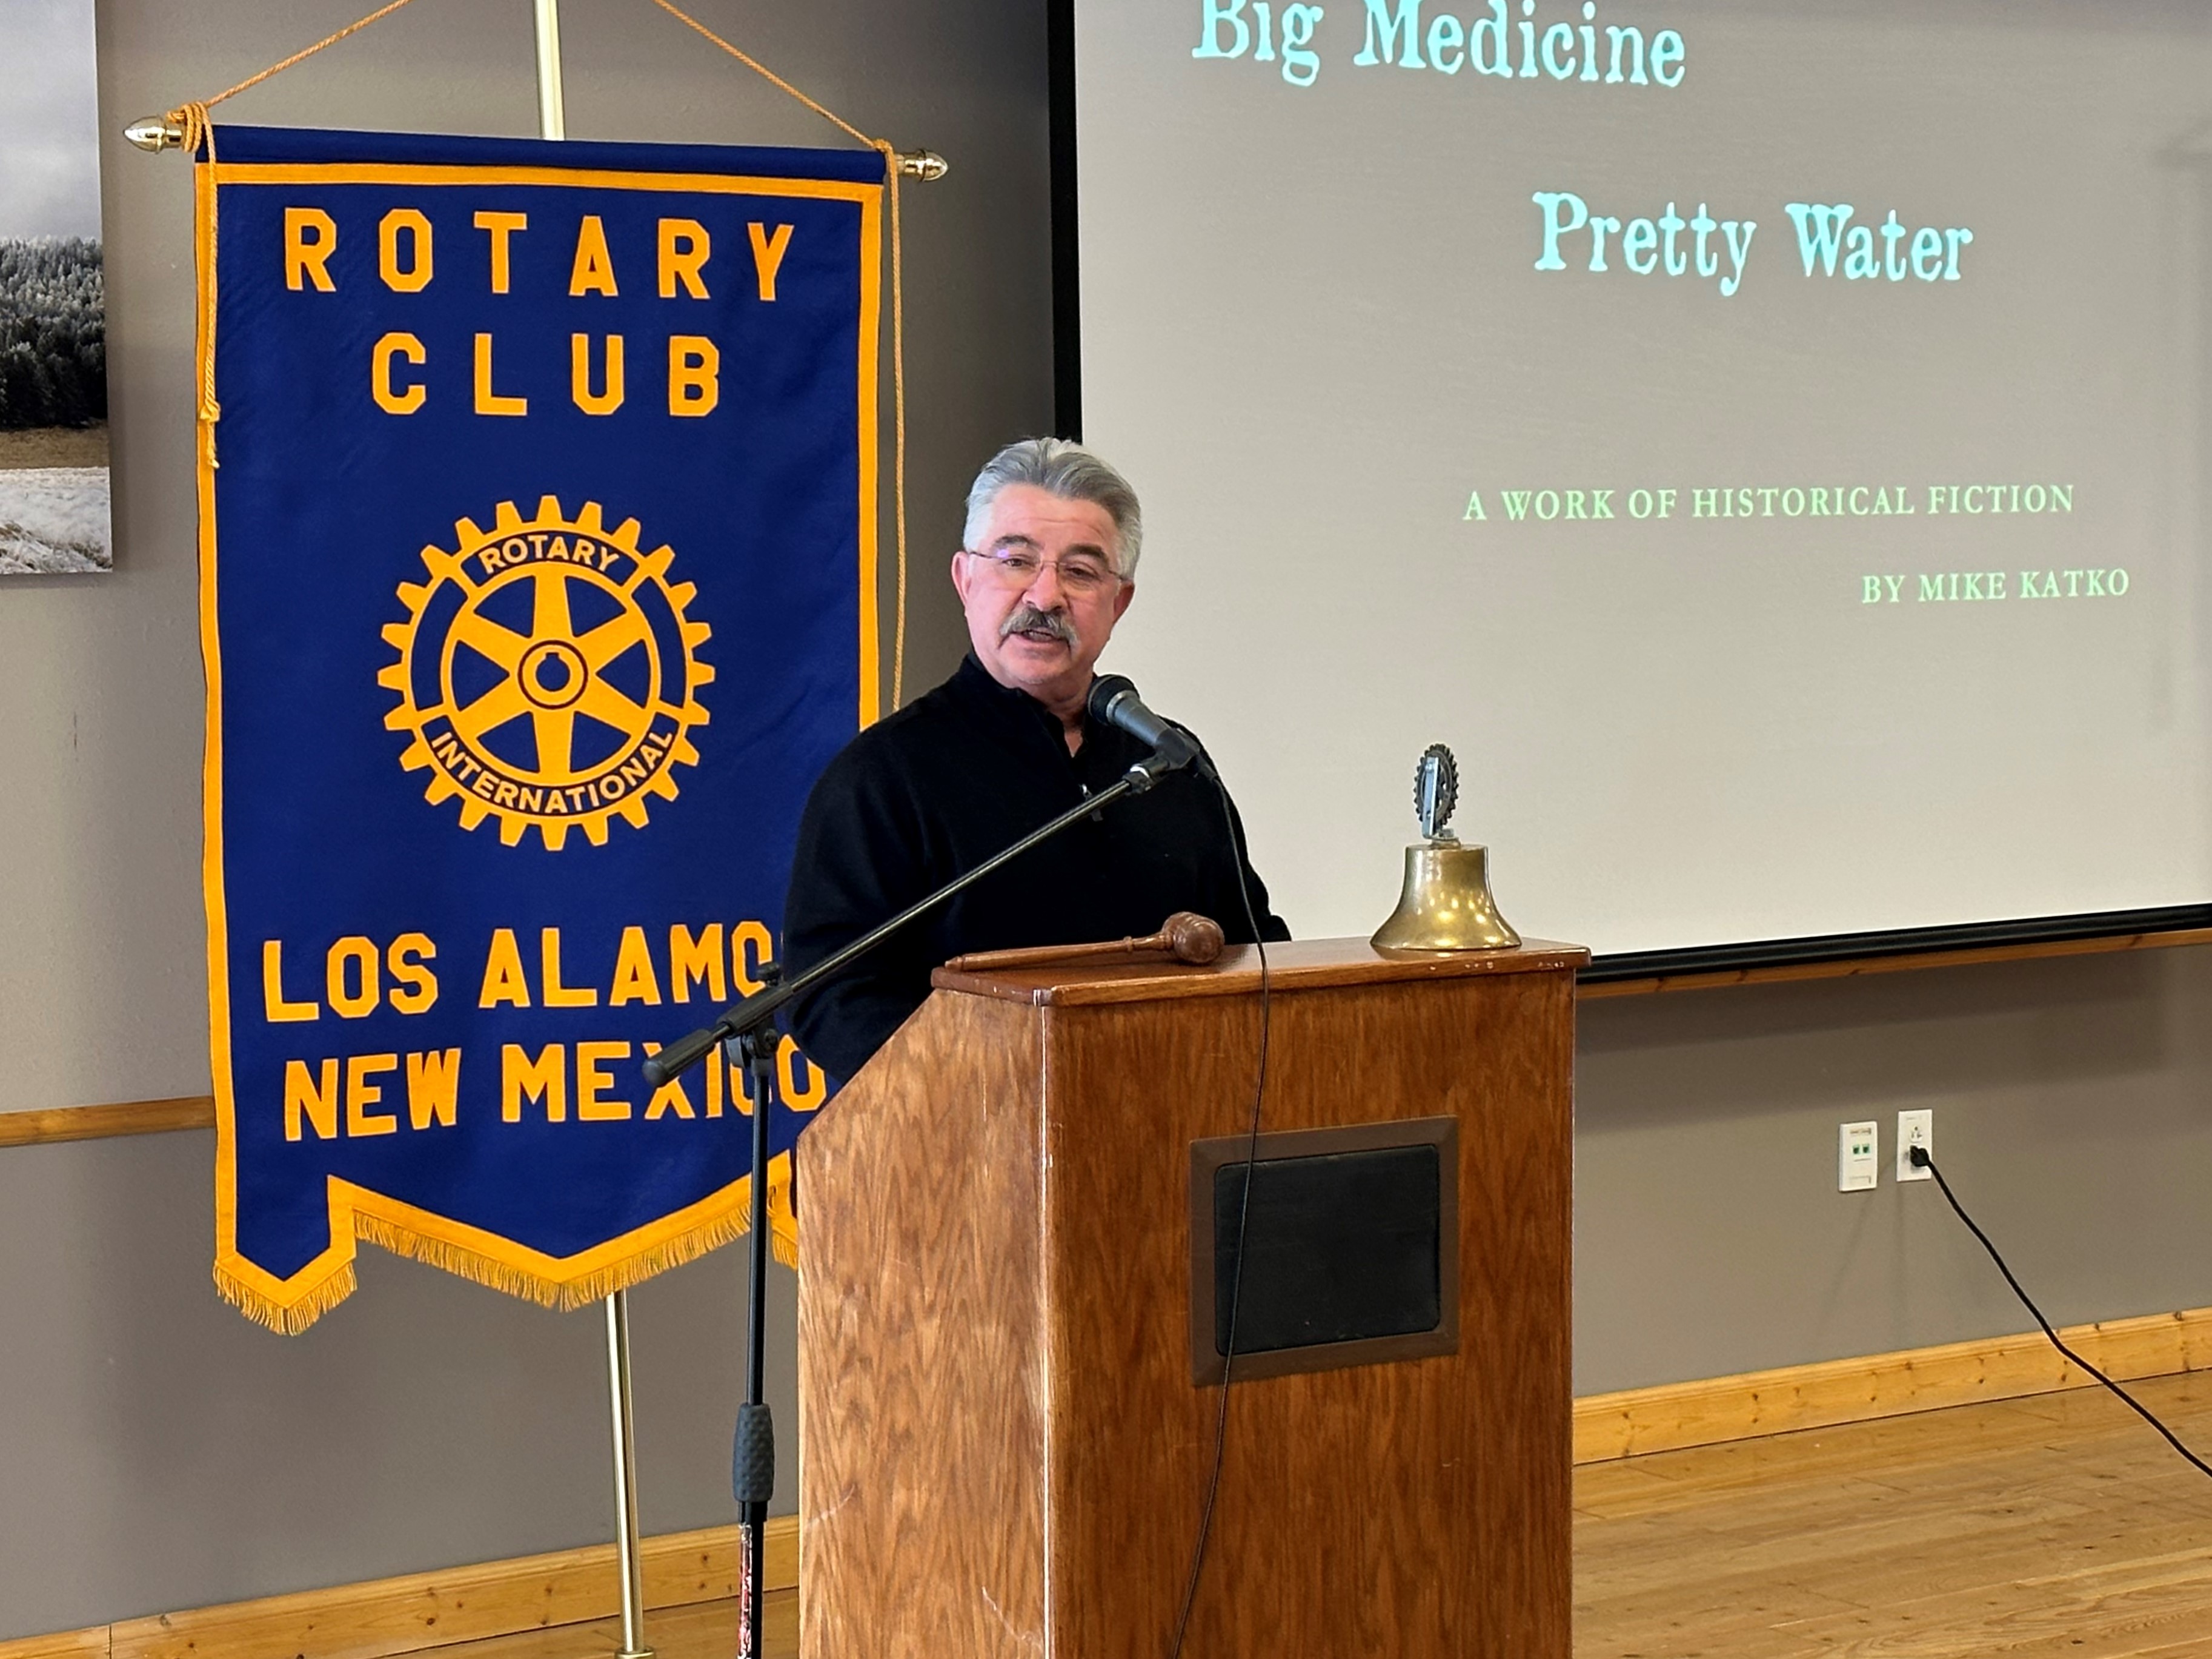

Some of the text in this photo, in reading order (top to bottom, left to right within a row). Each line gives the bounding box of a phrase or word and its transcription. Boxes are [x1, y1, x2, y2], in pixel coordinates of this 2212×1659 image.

[1192, 0, 1686, 87] Big Medicine
[285, 208, 792, 300] ROTARY
[1532, 191, 1972, 296] Pretty Water
[373, 333, 719, 416] CLUB
[1464, 483, 2071, 521] A WORK OF HISTORICAL FICTION
[479, 535, 619, 575] ROTARY
[1862, 568, 2129, 604] BY MIKE KATKO
[431, 730, 673, 813] INTERNATIONAL
[264, 921, 783, 1022] LOS ALAMO
[285, 1049, 460, 1140] NEW
